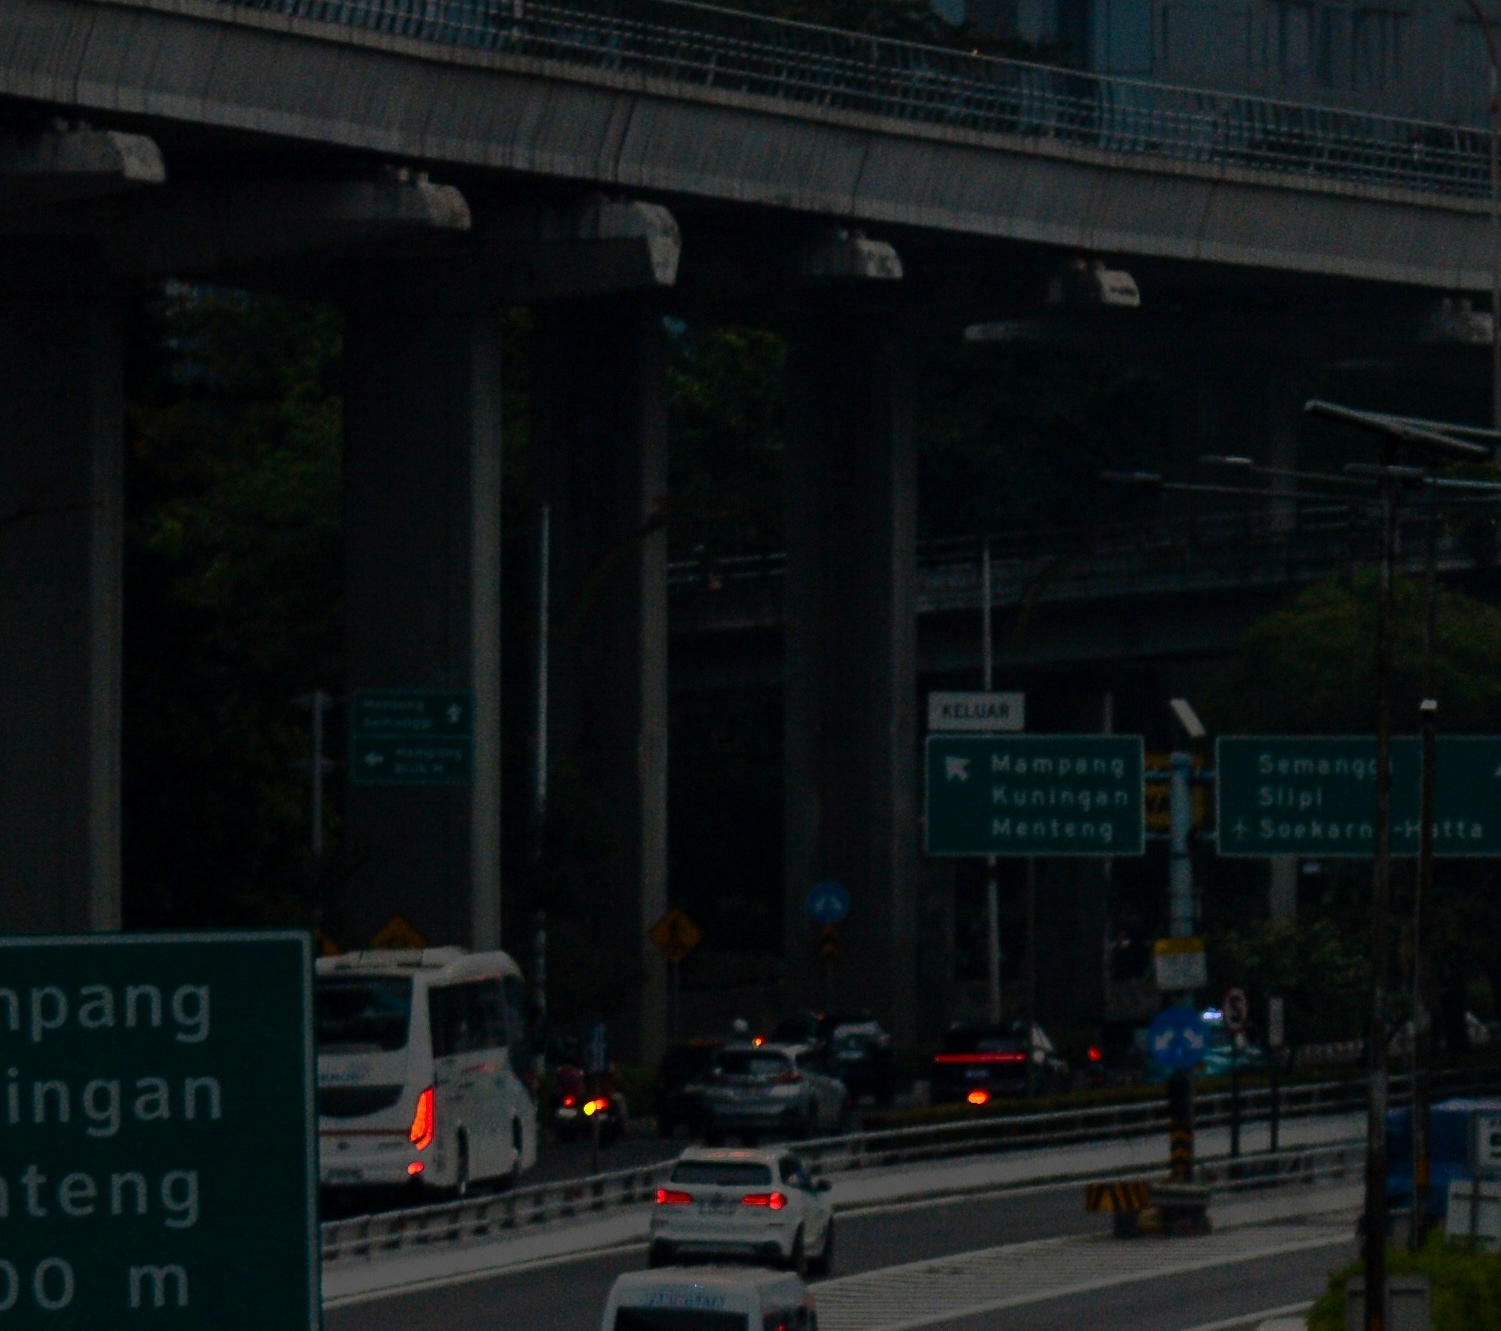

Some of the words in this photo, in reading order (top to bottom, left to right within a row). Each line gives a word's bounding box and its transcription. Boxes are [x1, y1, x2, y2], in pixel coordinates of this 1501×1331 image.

[991, 753, 1126, 780] Mampang
[991, 784, 1129, 813] Kuningan
[1259, 786, 1323, 812] Slipi
[991, 817, 1114, 844] Menteng
[129, 1263, 189, 1308] m
